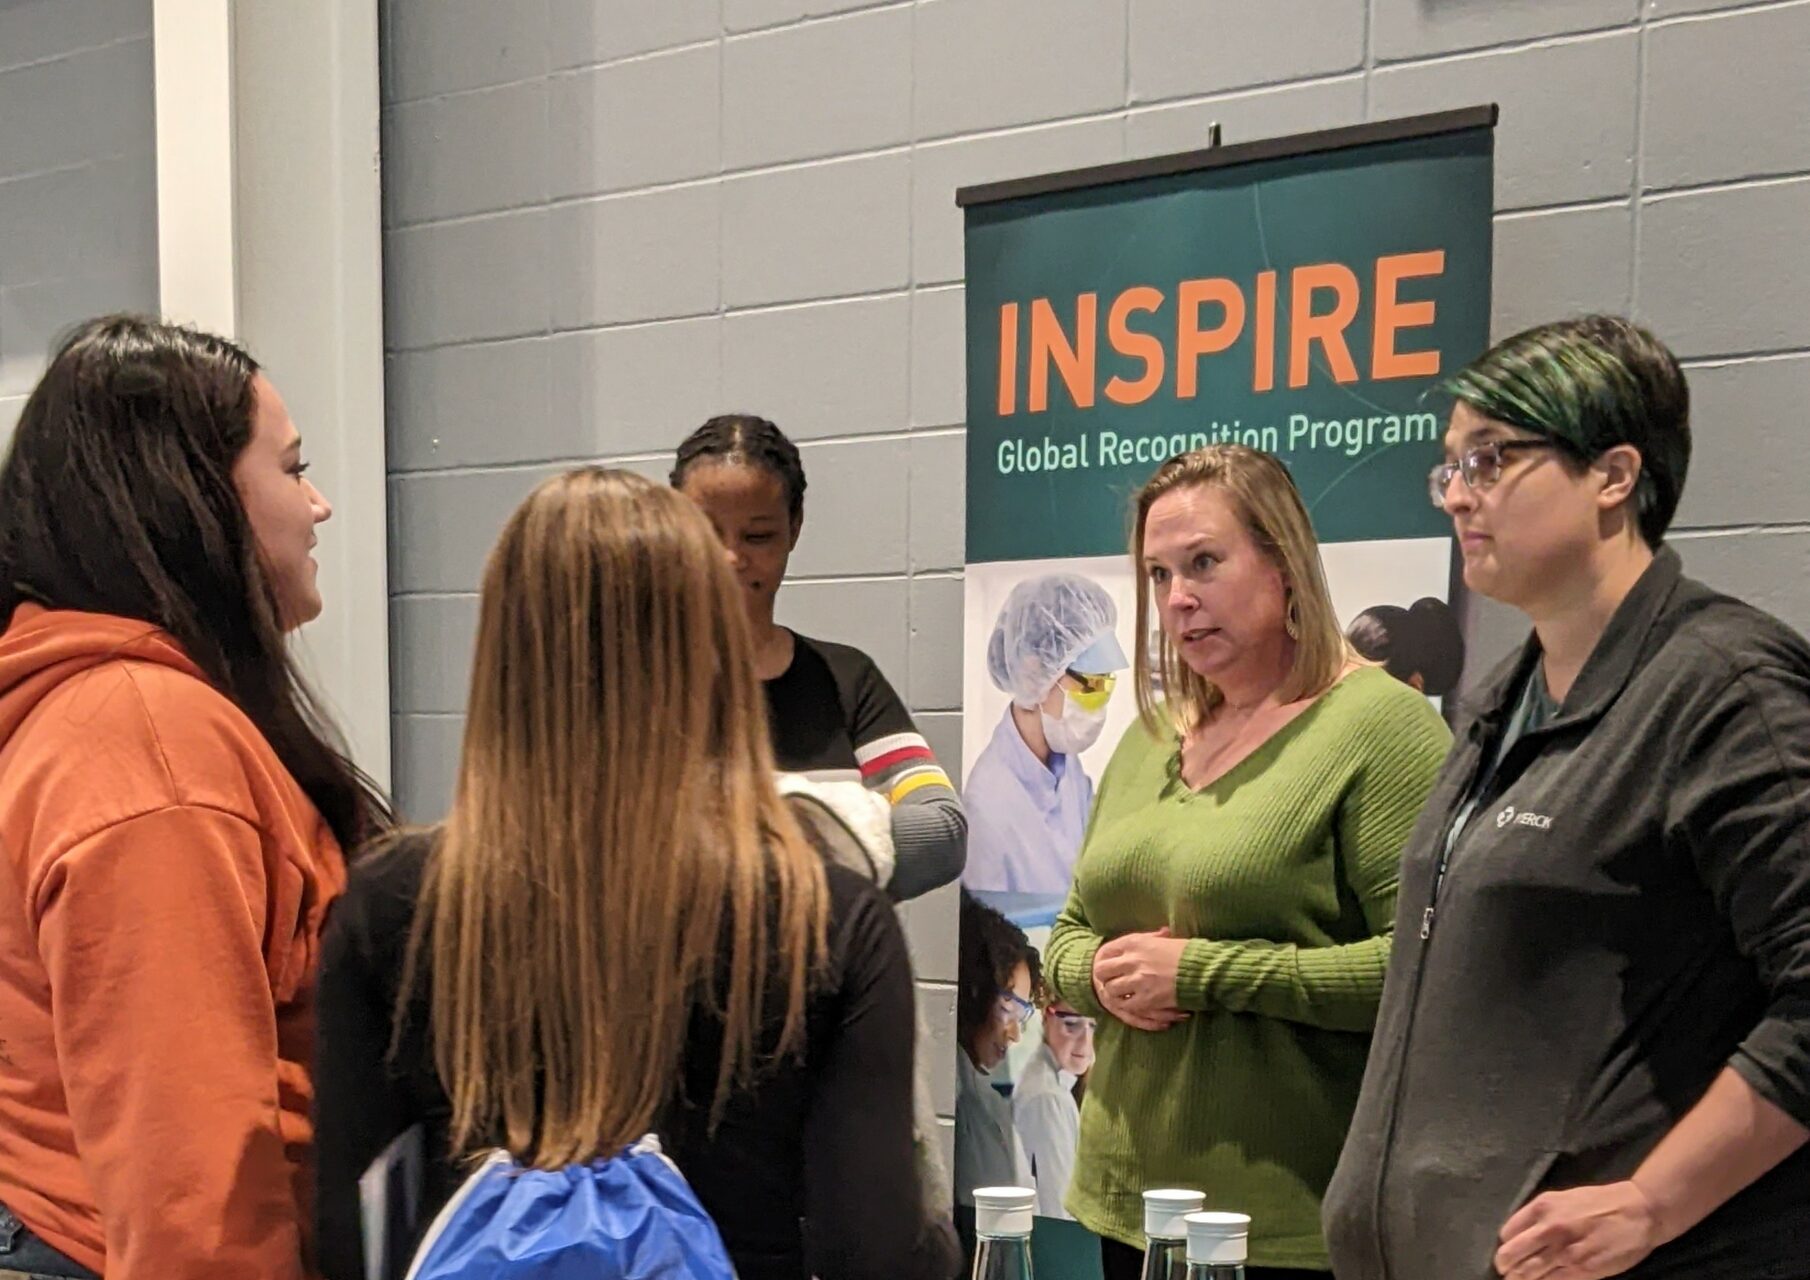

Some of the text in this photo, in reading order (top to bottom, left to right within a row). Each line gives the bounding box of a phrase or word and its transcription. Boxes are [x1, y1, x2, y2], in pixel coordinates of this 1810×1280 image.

[997, 249, 1446, 416] INSPIRE
[998, 433, 1088, 473] Global
[1289, 412, 1437, 456] Program
